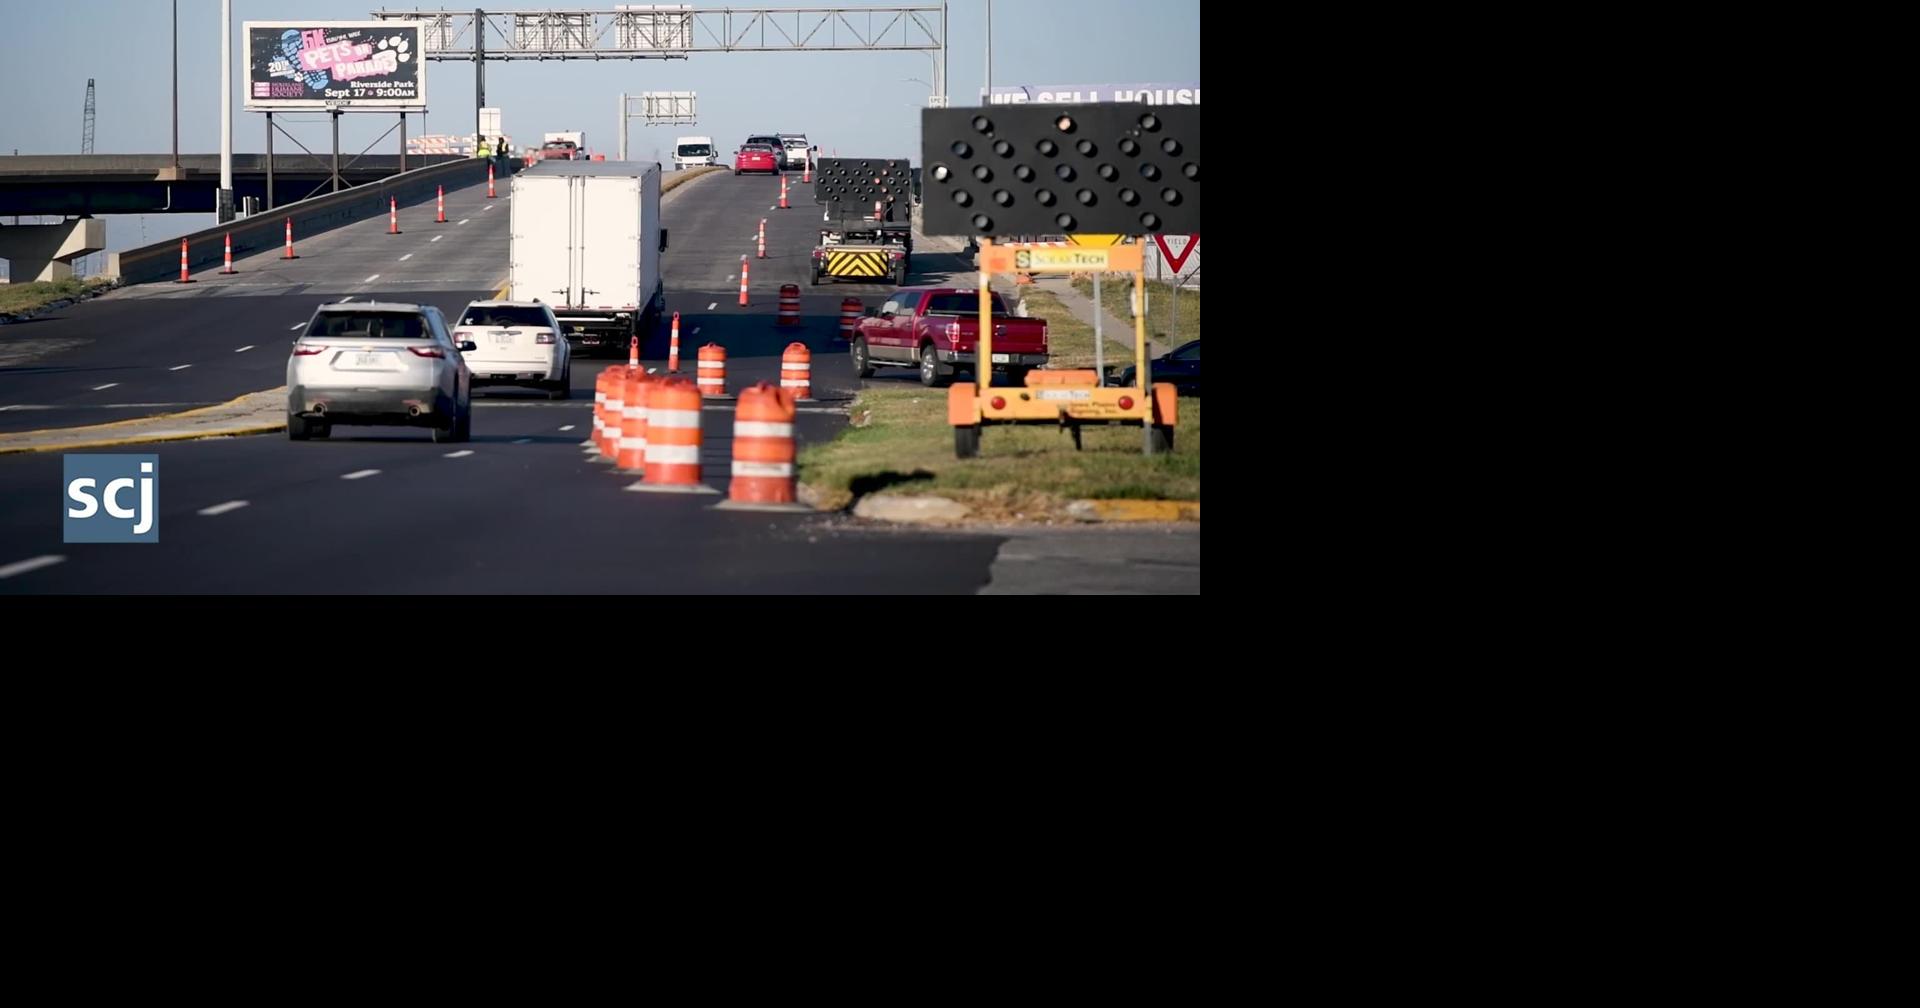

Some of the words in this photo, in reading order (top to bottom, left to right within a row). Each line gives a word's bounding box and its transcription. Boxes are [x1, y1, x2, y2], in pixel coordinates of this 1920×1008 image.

[303, 40, 352, 68] PETS
[324, 88, 351, 98] Sept
[354, 88, 366, 97] 17
[376, 88, 415, 97] 9:00AM
[1114, 88, 1200, 106] HOUS
